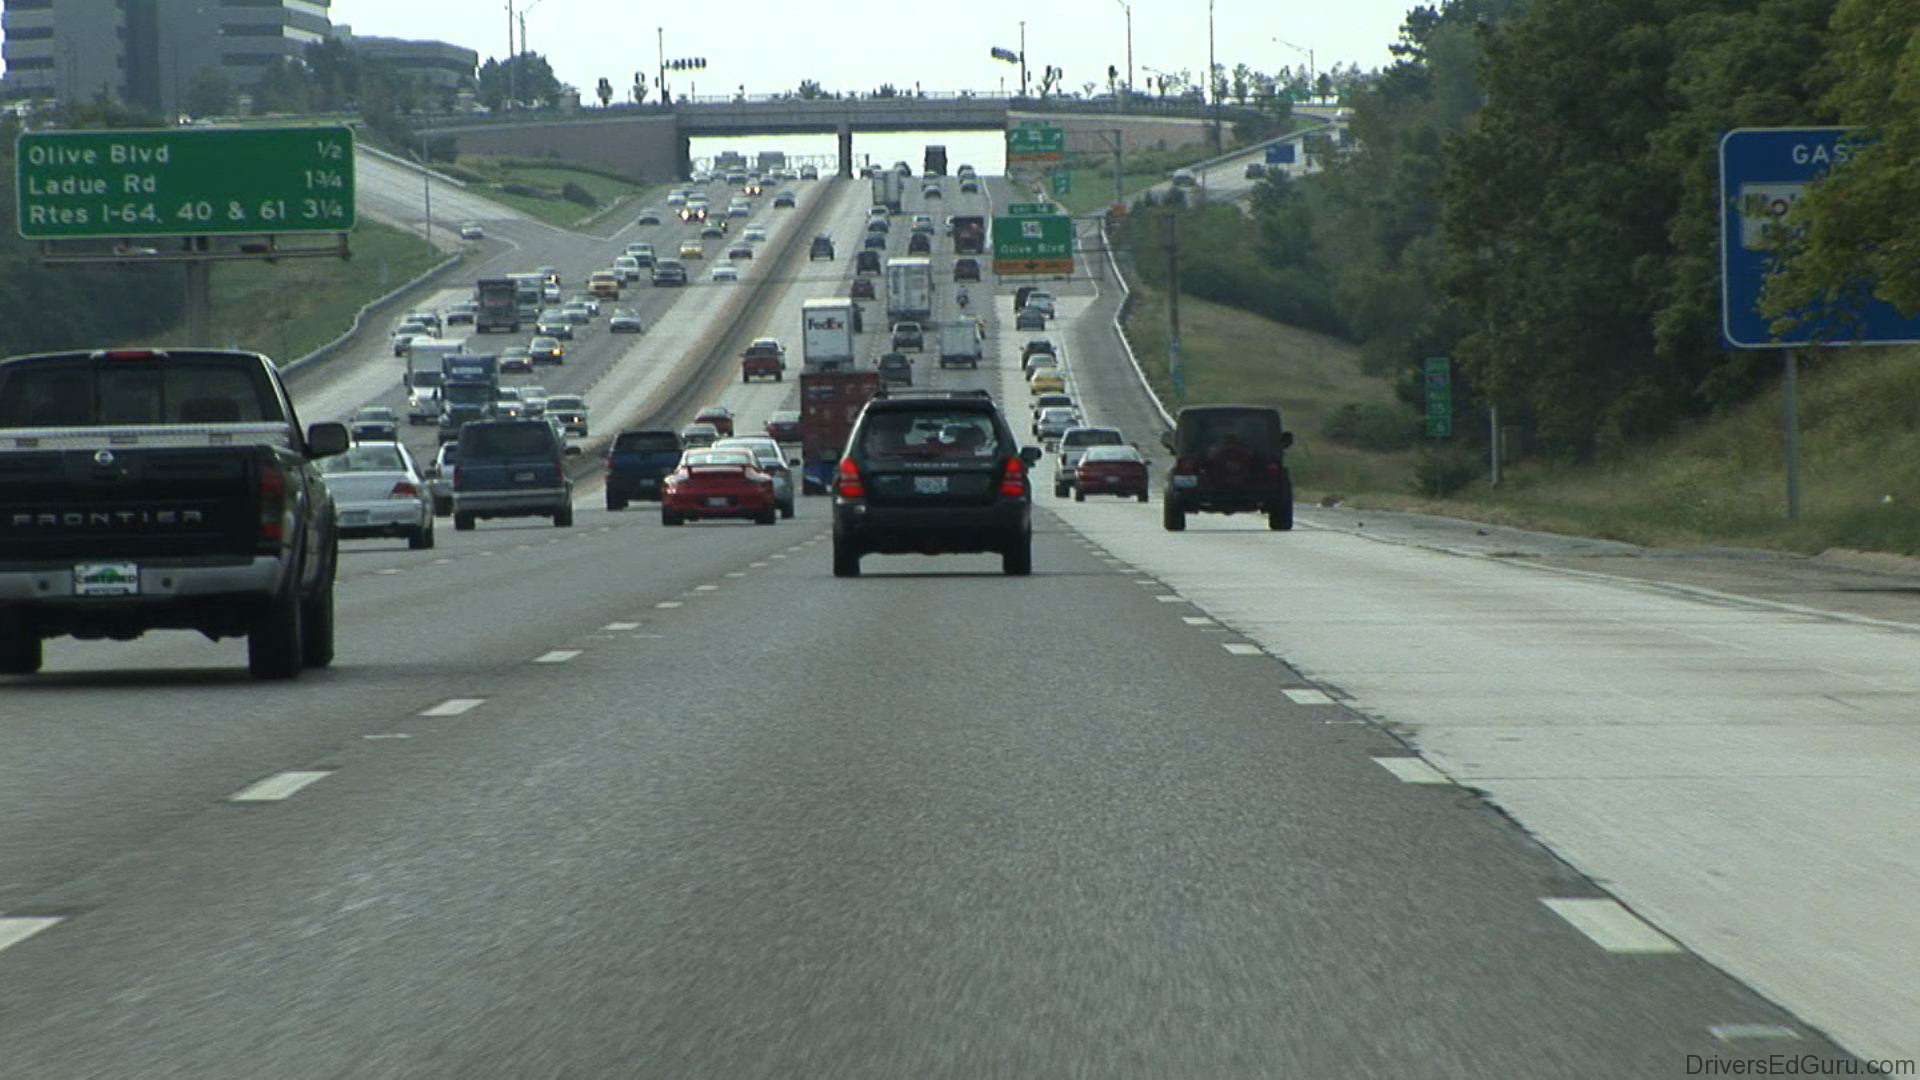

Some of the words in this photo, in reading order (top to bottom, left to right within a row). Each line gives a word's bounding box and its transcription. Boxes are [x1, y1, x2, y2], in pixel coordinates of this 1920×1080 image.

[29, 145, 97, 165] Olive
[110, 143, 169, 164] Blvd
[1792, 144, 1849, 164] GAS
[29, 174, 107, 195] Ladue
[124, 173, 156, 193] Rd
[29, 204, 89, 224] Rtes
[177, 201, 212, 220] 40
[228, 200, 245, 220] &
[260, 200, 285, 220] 61
[808, 317, 845, 331] FedEx
[13, 510, 202, 526] FRONTIER
